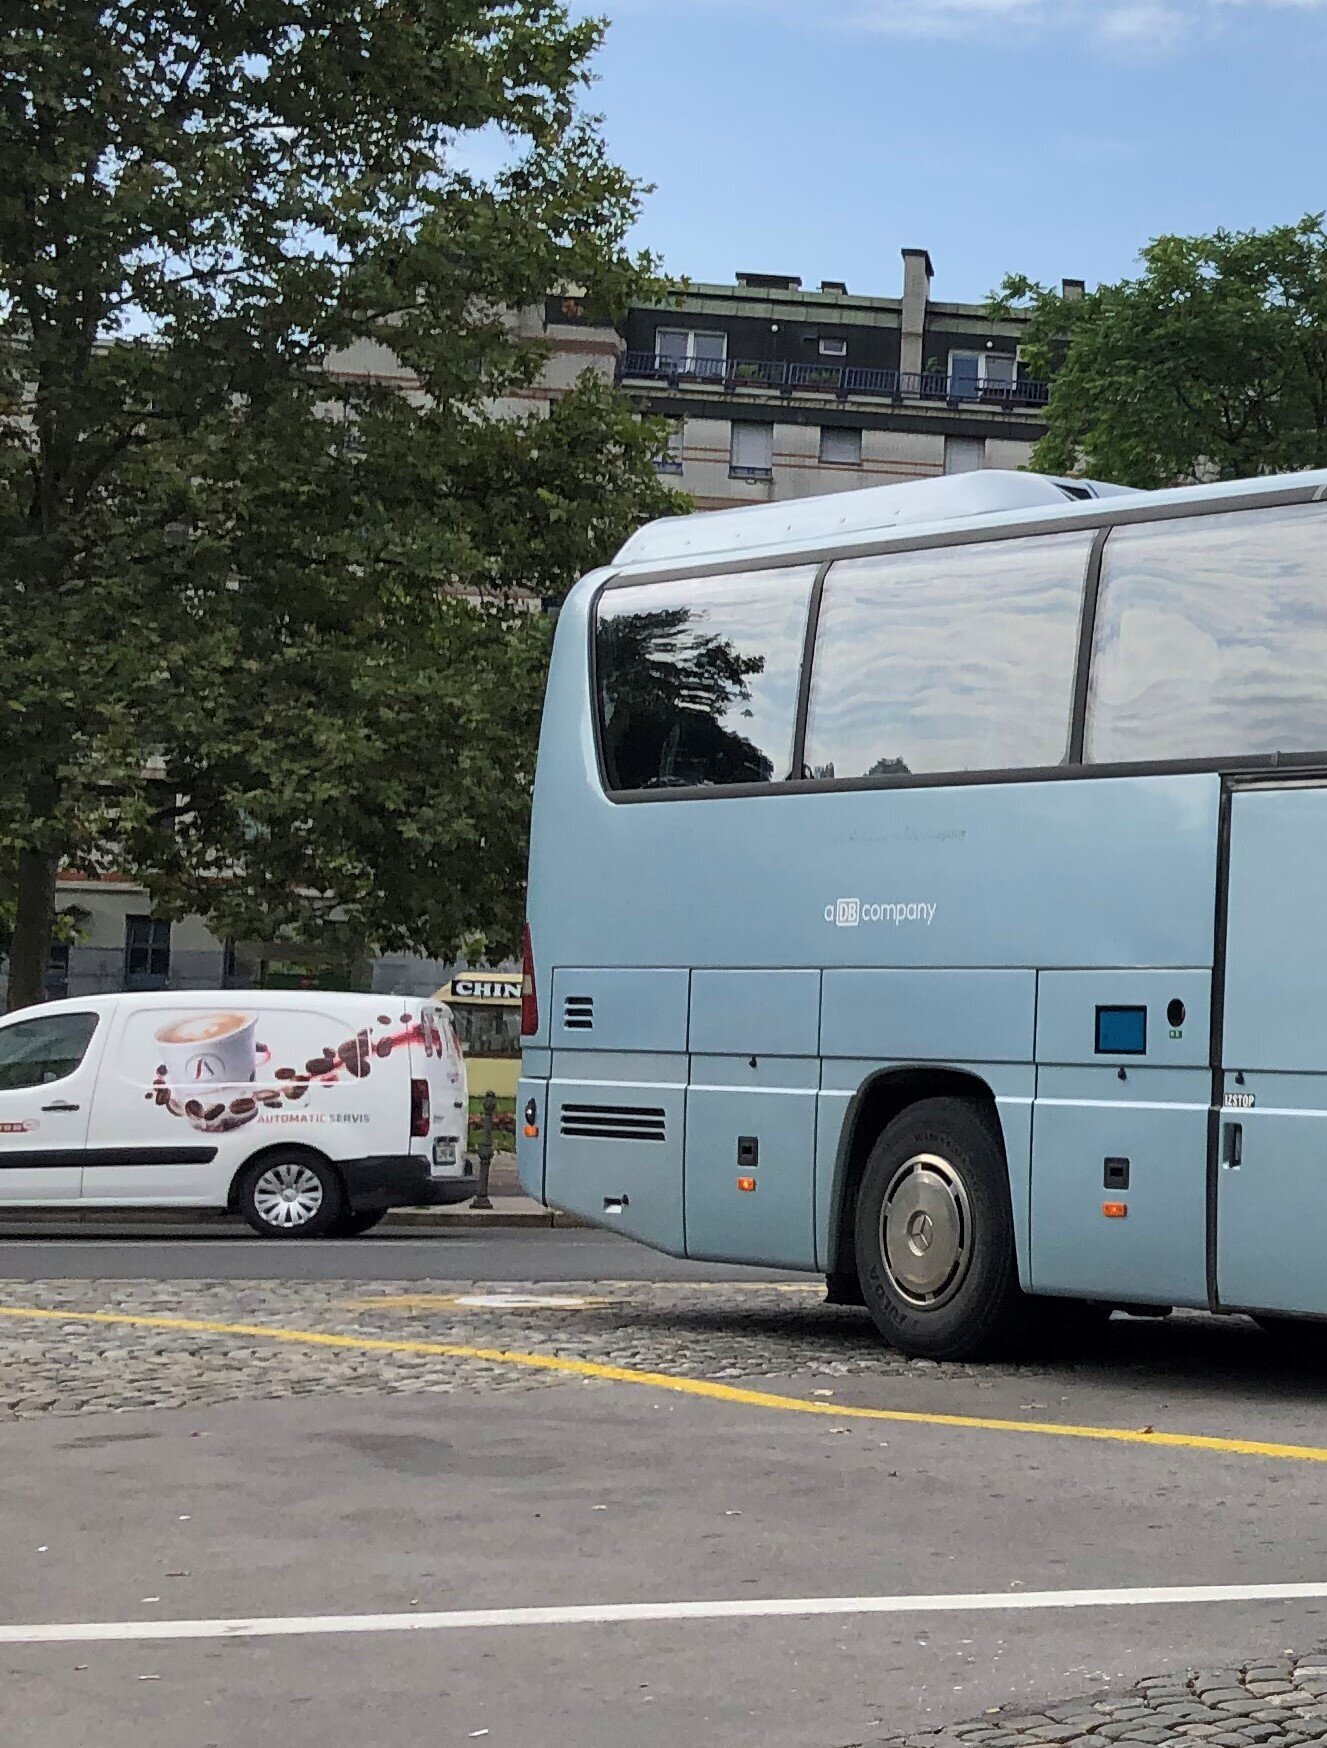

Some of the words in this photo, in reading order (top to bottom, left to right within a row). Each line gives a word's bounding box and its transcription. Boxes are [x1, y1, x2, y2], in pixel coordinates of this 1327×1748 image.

[824, 904, 834, 922] a
[838, 900, 859, 924] DB
[862, 903, 937, 926] company
[1224, 1094, 1255, 1107] IZSTOP
[257, 1113, 326, 1124] AUTOMATIC
[328, 1113, 370, 1123] SERVIS
